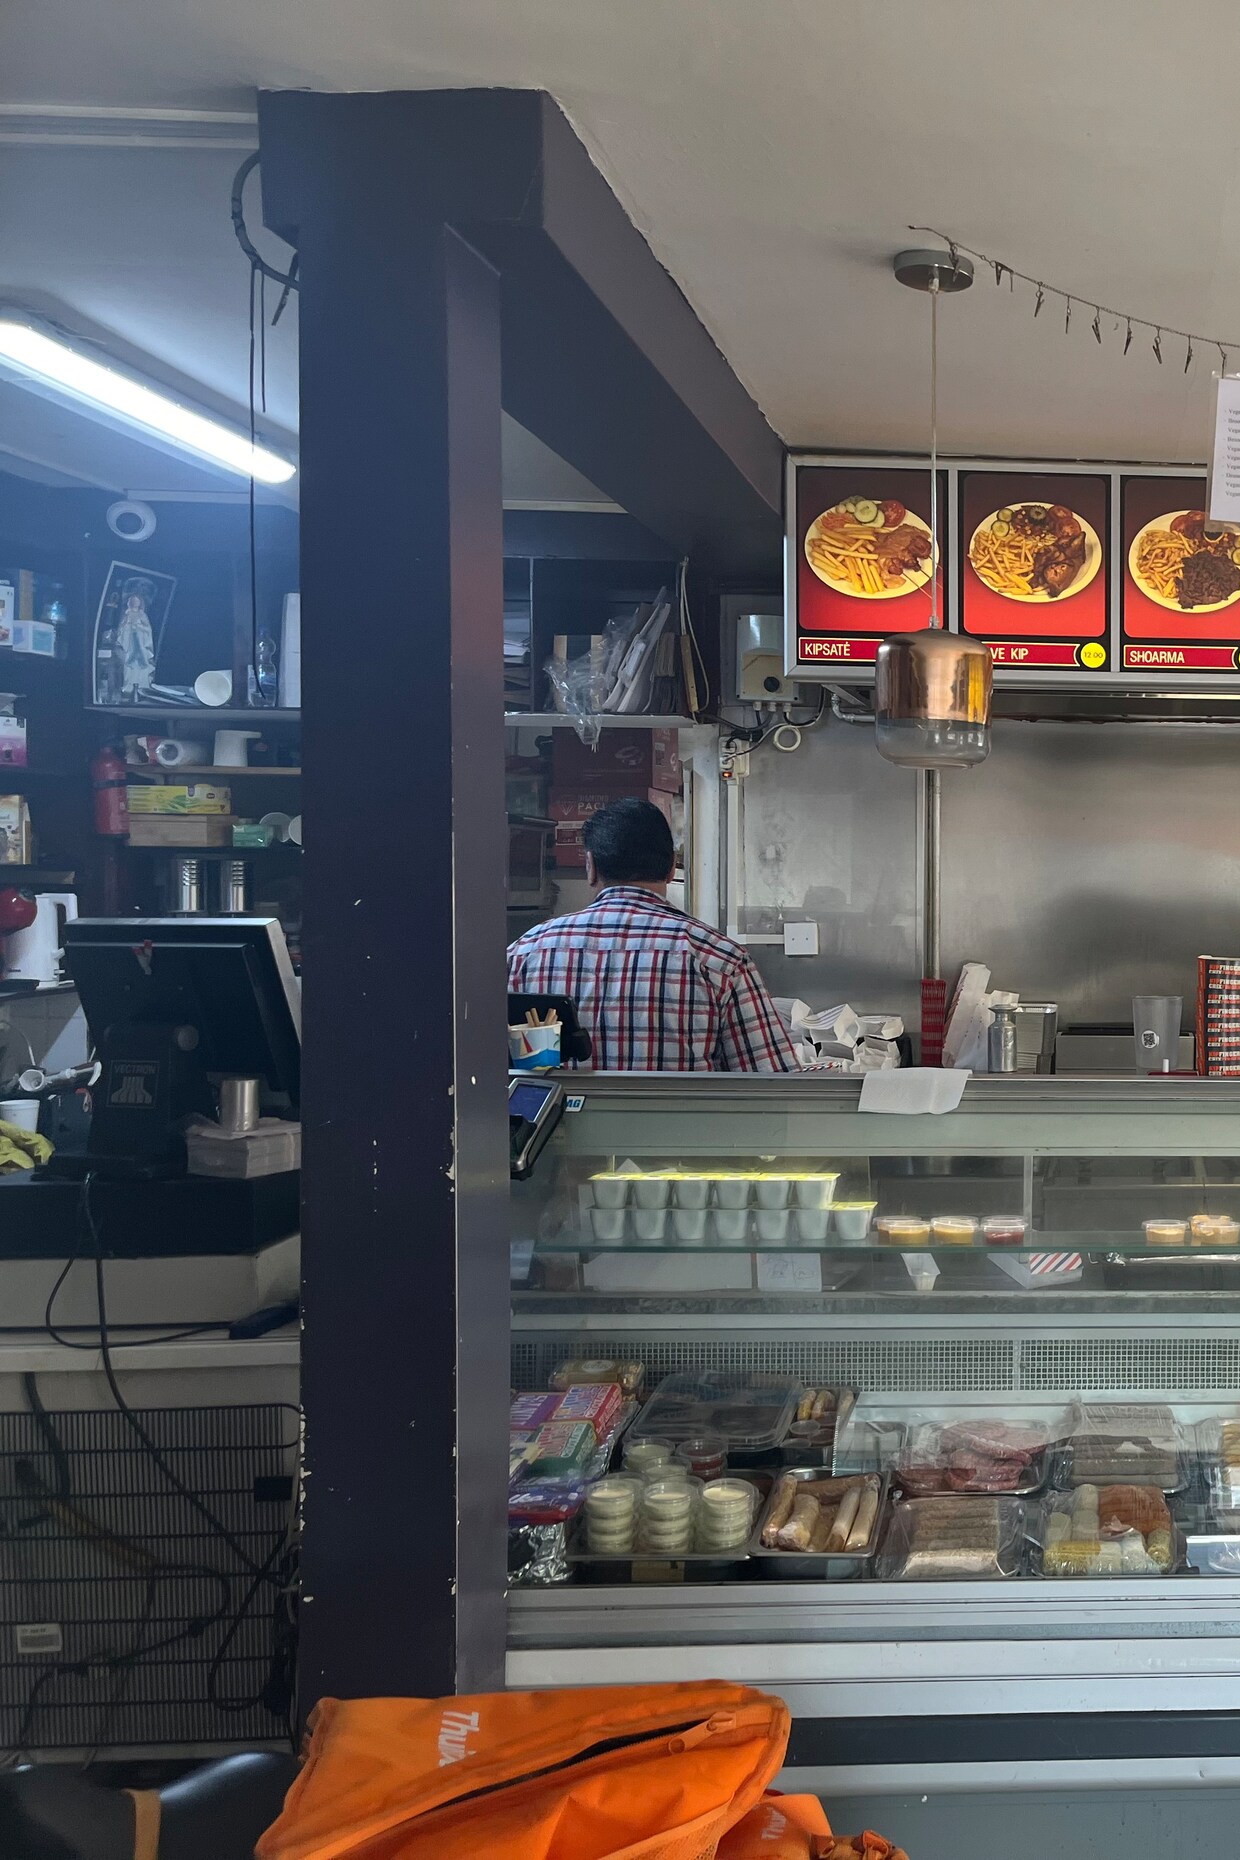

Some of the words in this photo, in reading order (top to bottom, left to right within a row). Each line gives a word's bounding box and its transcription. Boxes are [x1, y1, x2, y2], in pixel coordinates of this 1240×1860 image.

[804, 641, 851, 657] KIPSATÉ
[1010, 648, 1029, 661] KIP
[1129, 650, 1186, 664] SHOARMA
